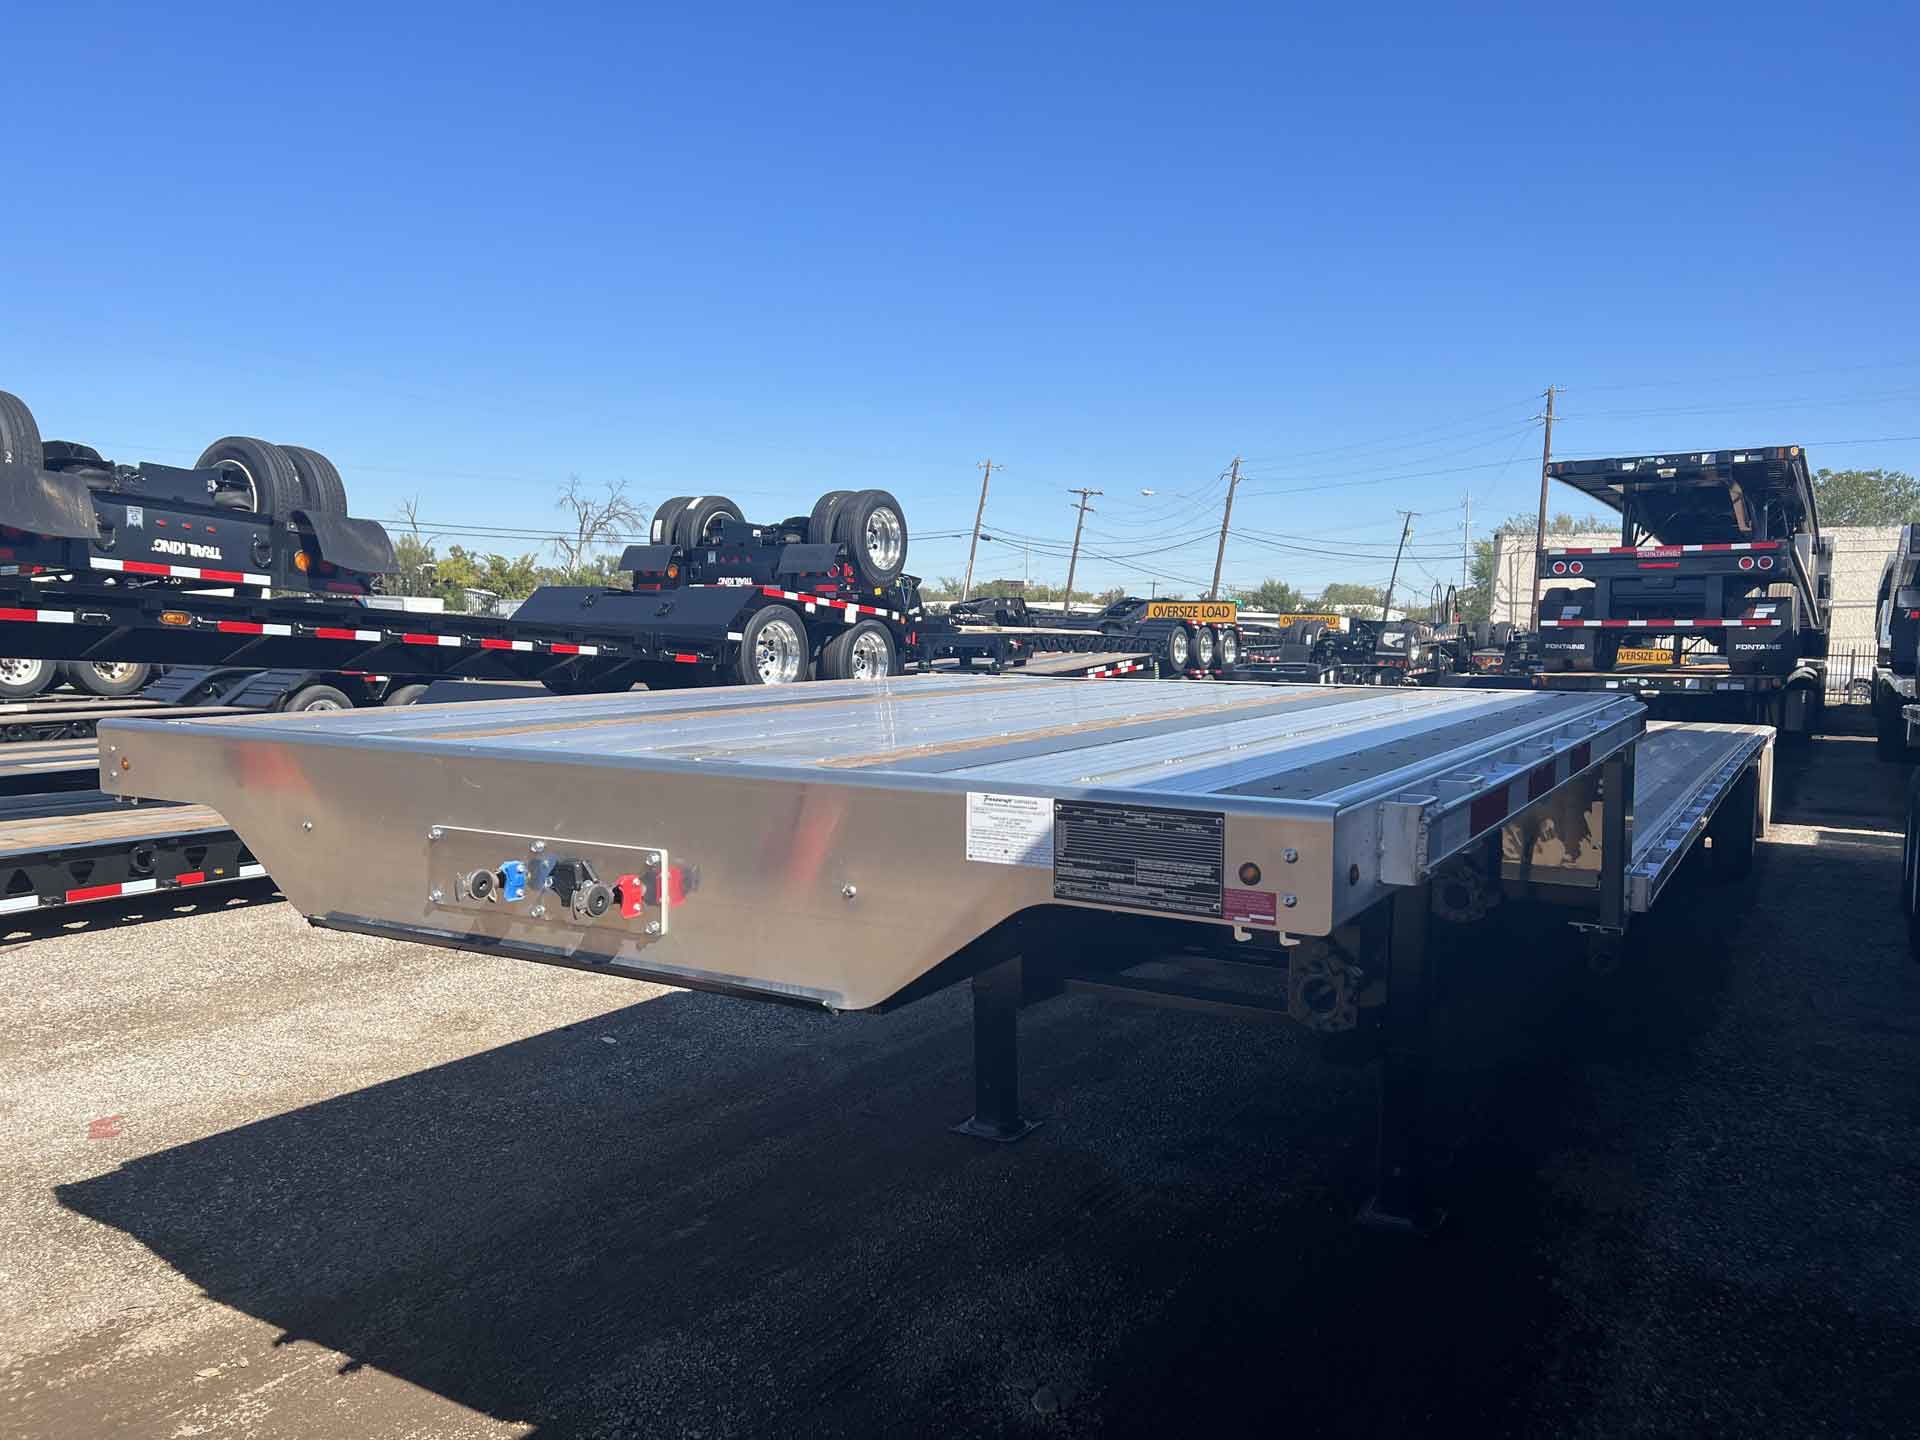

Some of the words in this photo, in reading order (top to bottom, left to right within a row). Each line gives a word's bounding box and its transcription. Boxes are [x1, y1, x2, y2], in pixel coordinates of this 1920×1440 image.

[153, 539, 186, 555] KING
[187, 543, 222, 560] TRAIL
[1153, 606, 1198, 618] OVERSIZE
[1201, 605, 1230, 618] LOAD
